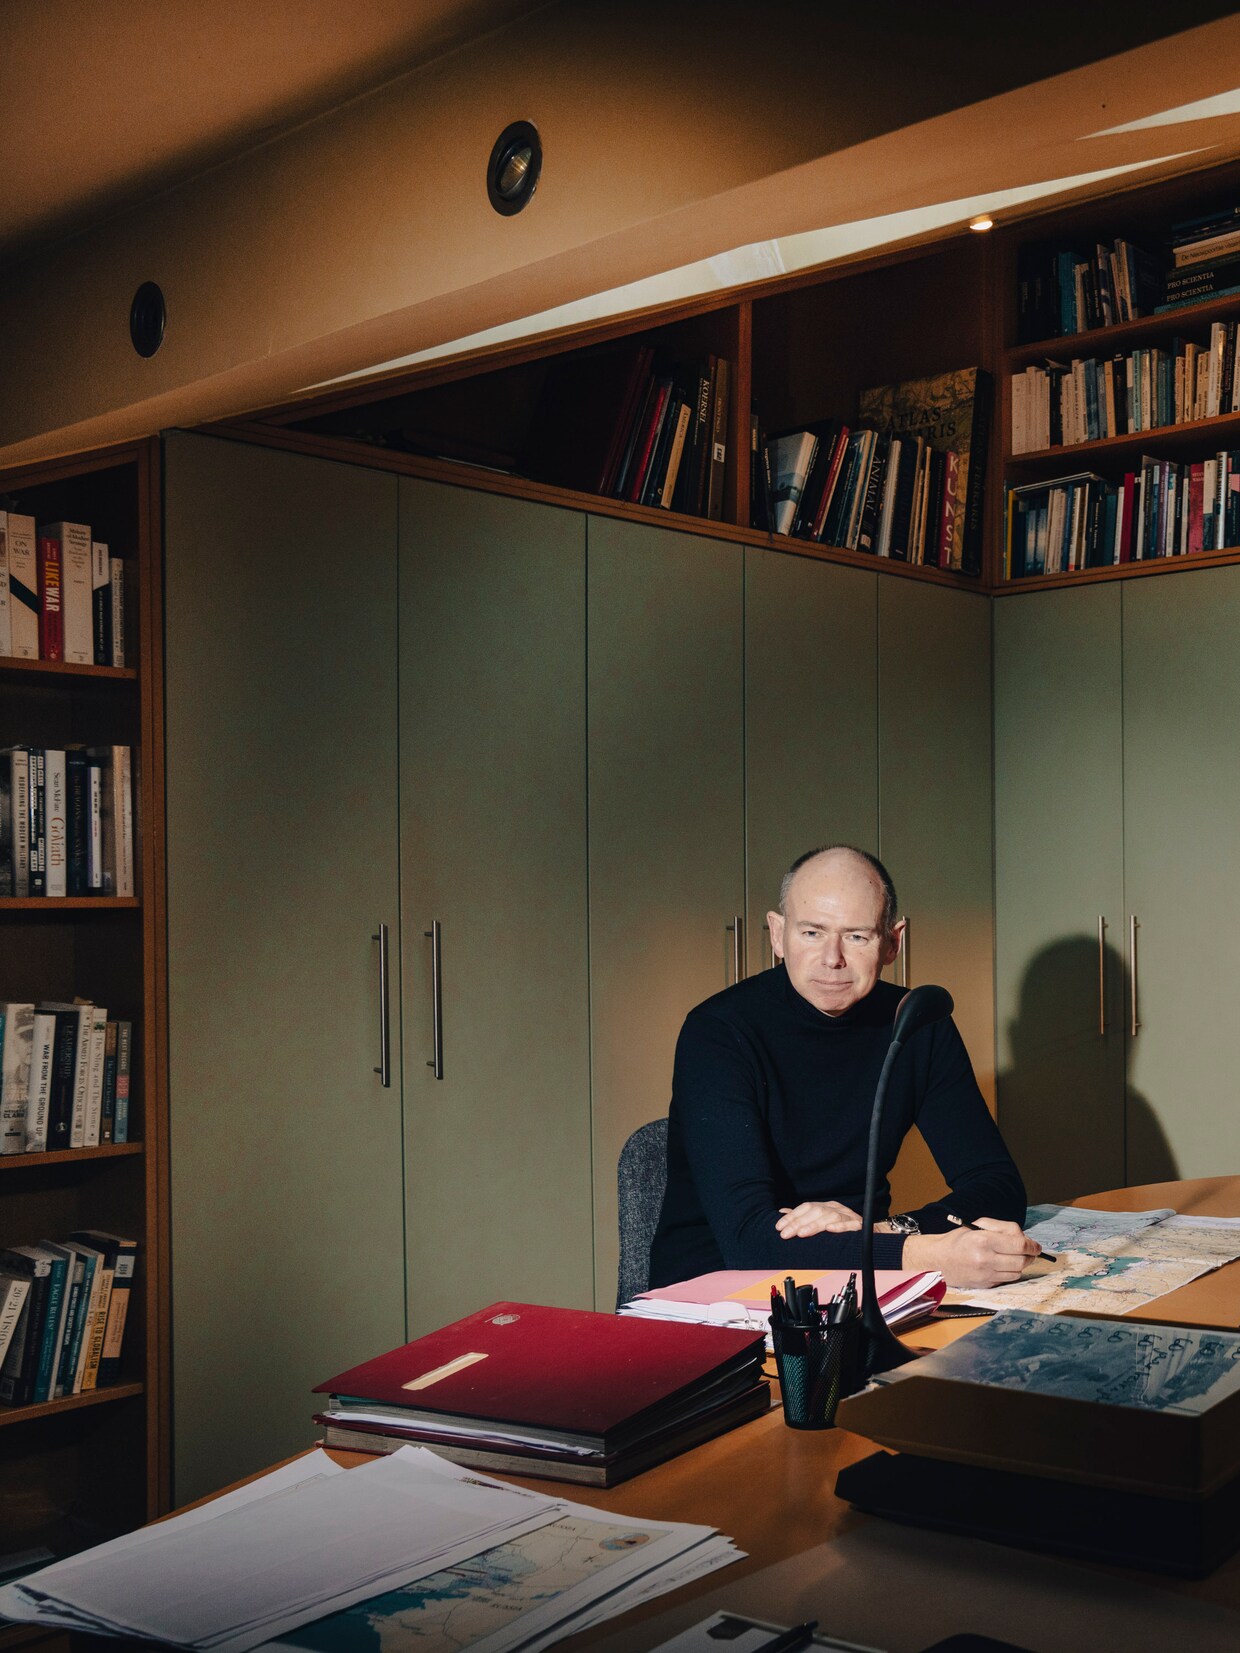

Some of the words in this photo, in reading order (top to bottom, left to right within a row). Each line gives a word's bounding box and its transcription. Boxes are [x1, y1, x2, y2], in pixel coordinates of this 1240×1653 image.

[1167, 280, 1181, 289] PRO
[1182, 271, 1215, 286] SCIENTIA
[1166, 292, 1180, 302] PRO
[1181, 284, 1214, 299] SCIENTIA
[888, 406, 942, 435] ATLAS
[942, 455, 959, 566] KUNST
[44, 560, 61, 613] LIKEWAR
[54, 773, 62, 788] Sean
[54, 789, 62, 813] McFate
[50, 817, 65, 867] Goliath
[42, 1044, 50, 1060] WAR
[95, 1037, 104, 1050] The
[92, 1054, 103, 1072] Sling
[39, 1083, 47, 1095] THE
[92, 1075, 101, 1089] and
[91, 1091, 101, 1105] The
[37, 1097, 46, 1125] GROUND
[89, 1107, 98, 1130] Stone
[36, 1127, 43, 1137] UP
[96, 1311, 107, 1324] RISE
[94, 1326, 103, 1335] TO
[89, 1336, 102, 1370] GLOBALISM
